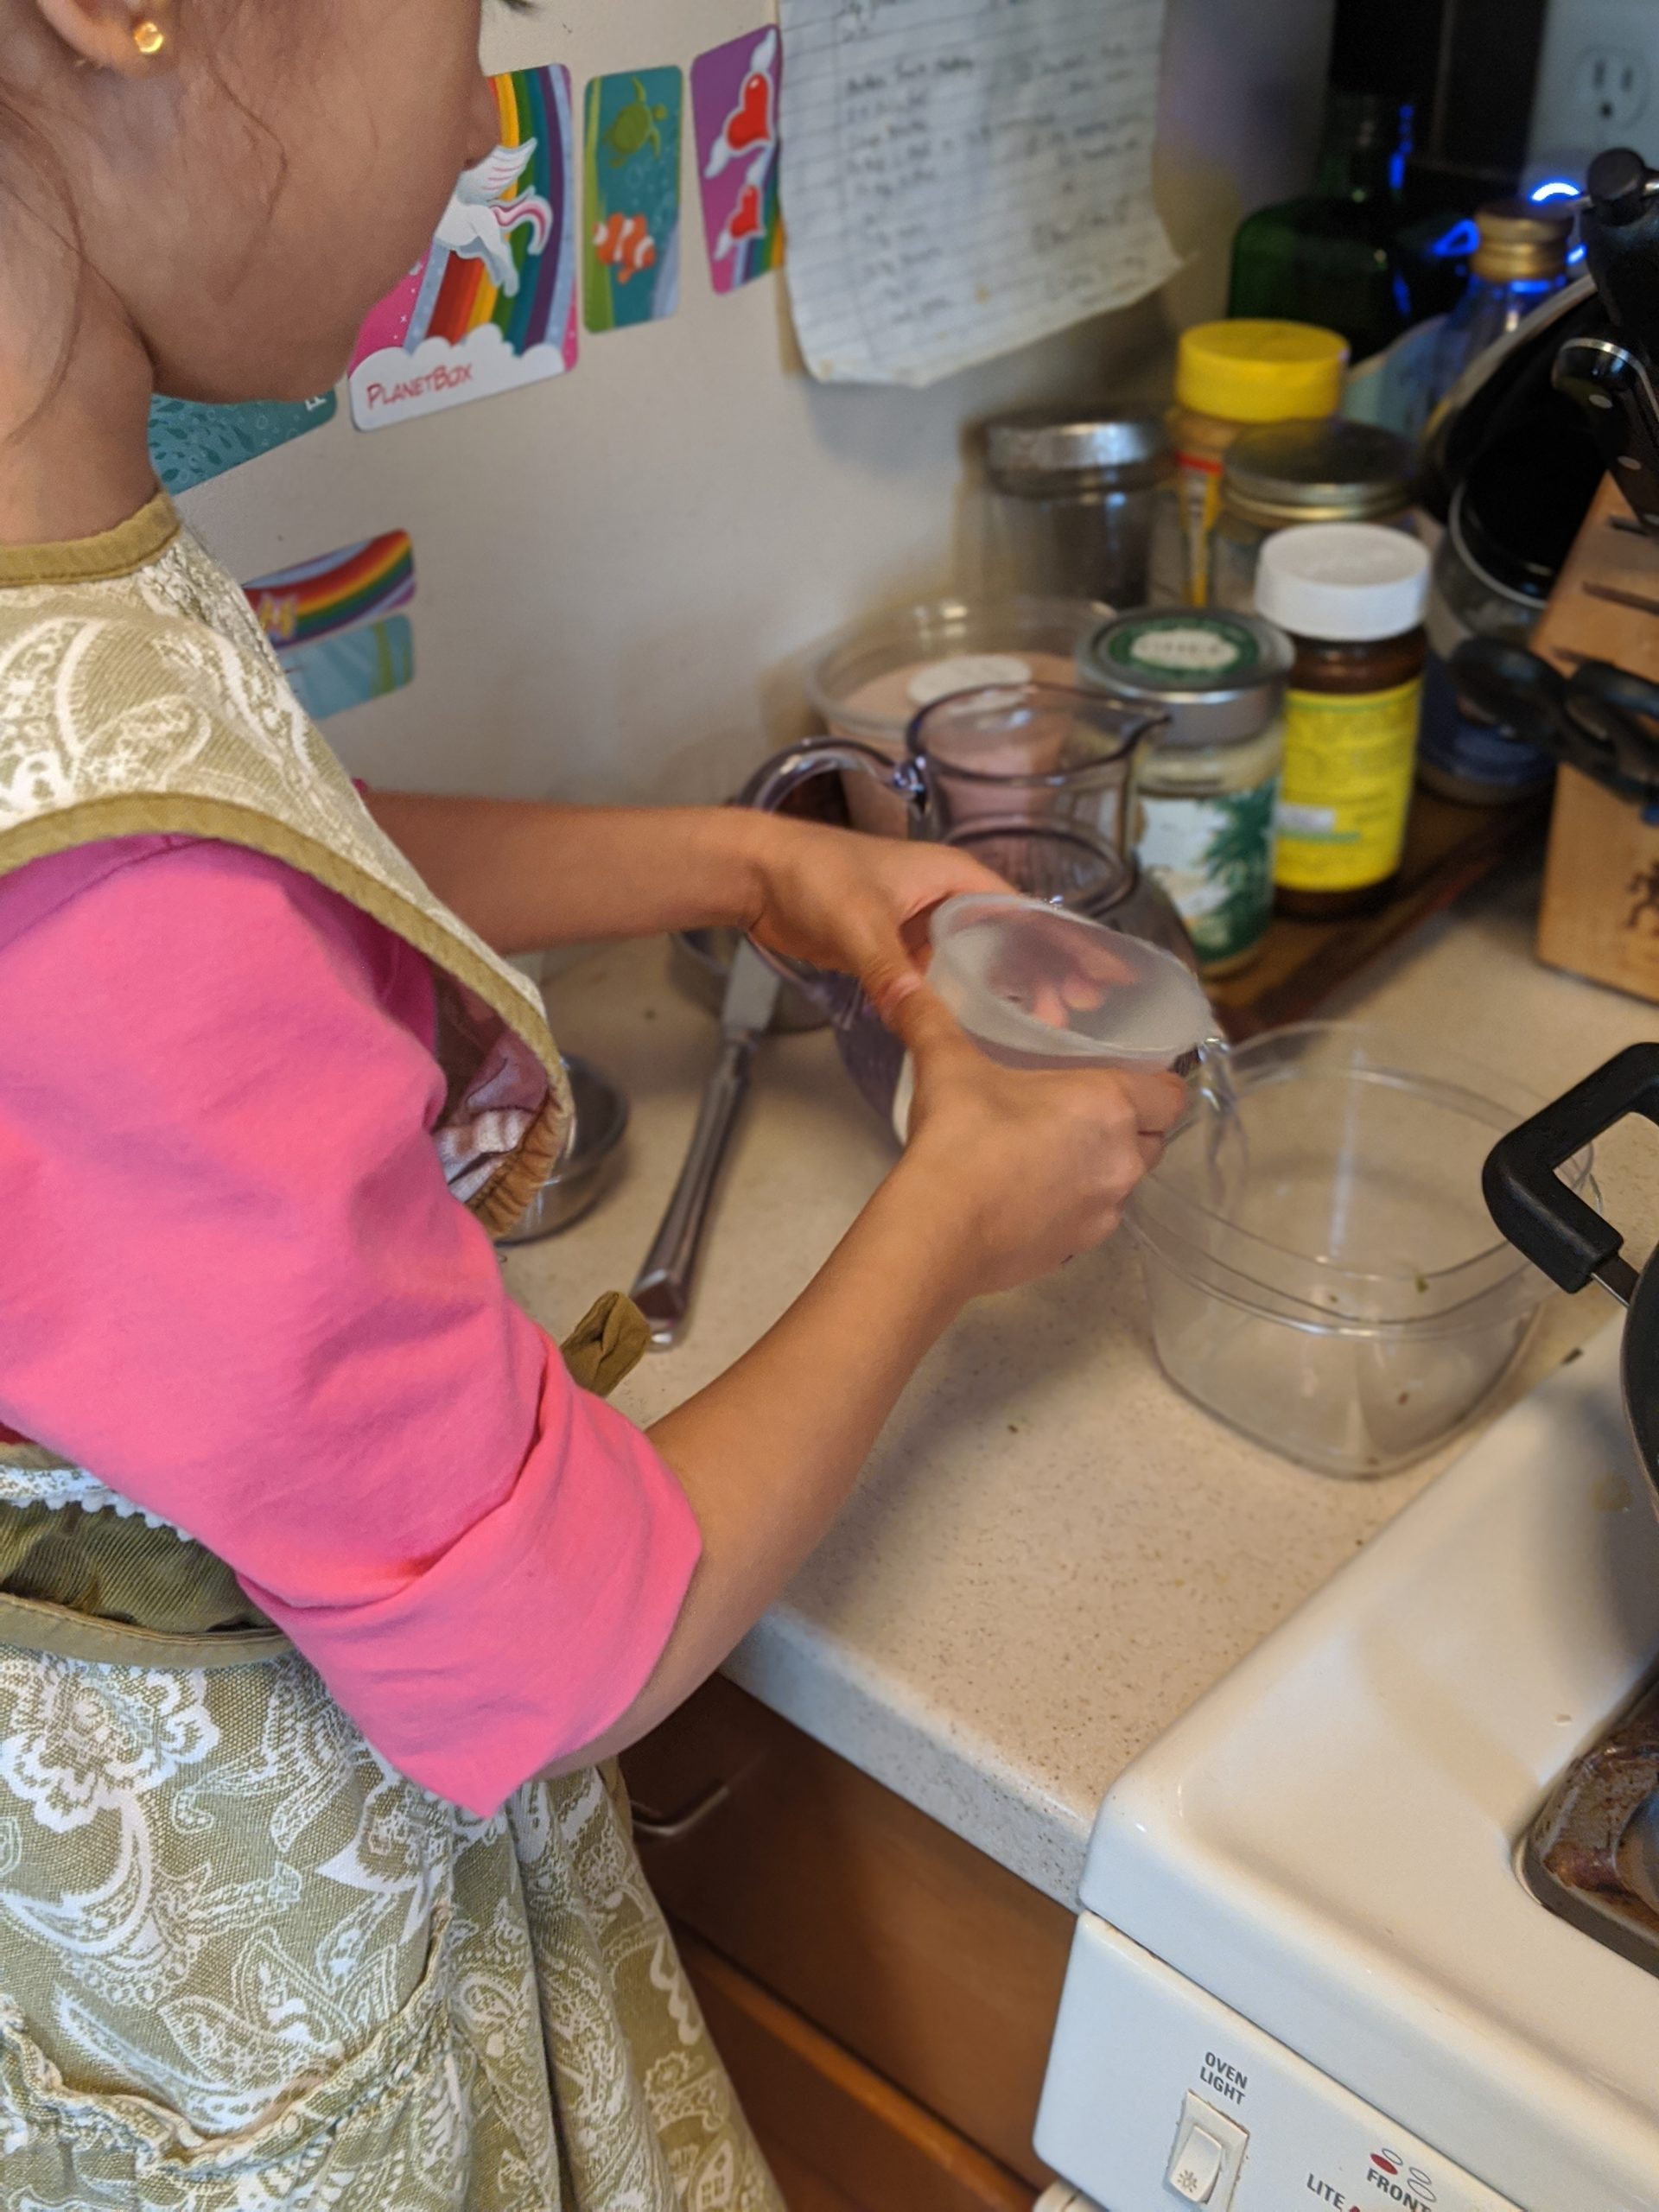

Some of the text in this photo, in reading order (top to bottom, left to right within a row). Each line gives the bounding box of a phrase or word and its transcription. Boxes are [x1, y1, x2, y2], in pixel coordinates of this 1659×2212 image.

[1199, 2066, 1246, 2105] LIGHT
[1205, 2051, 1248, 2089] OVEN
[1306, 2173, 1345, 2212] LITE
